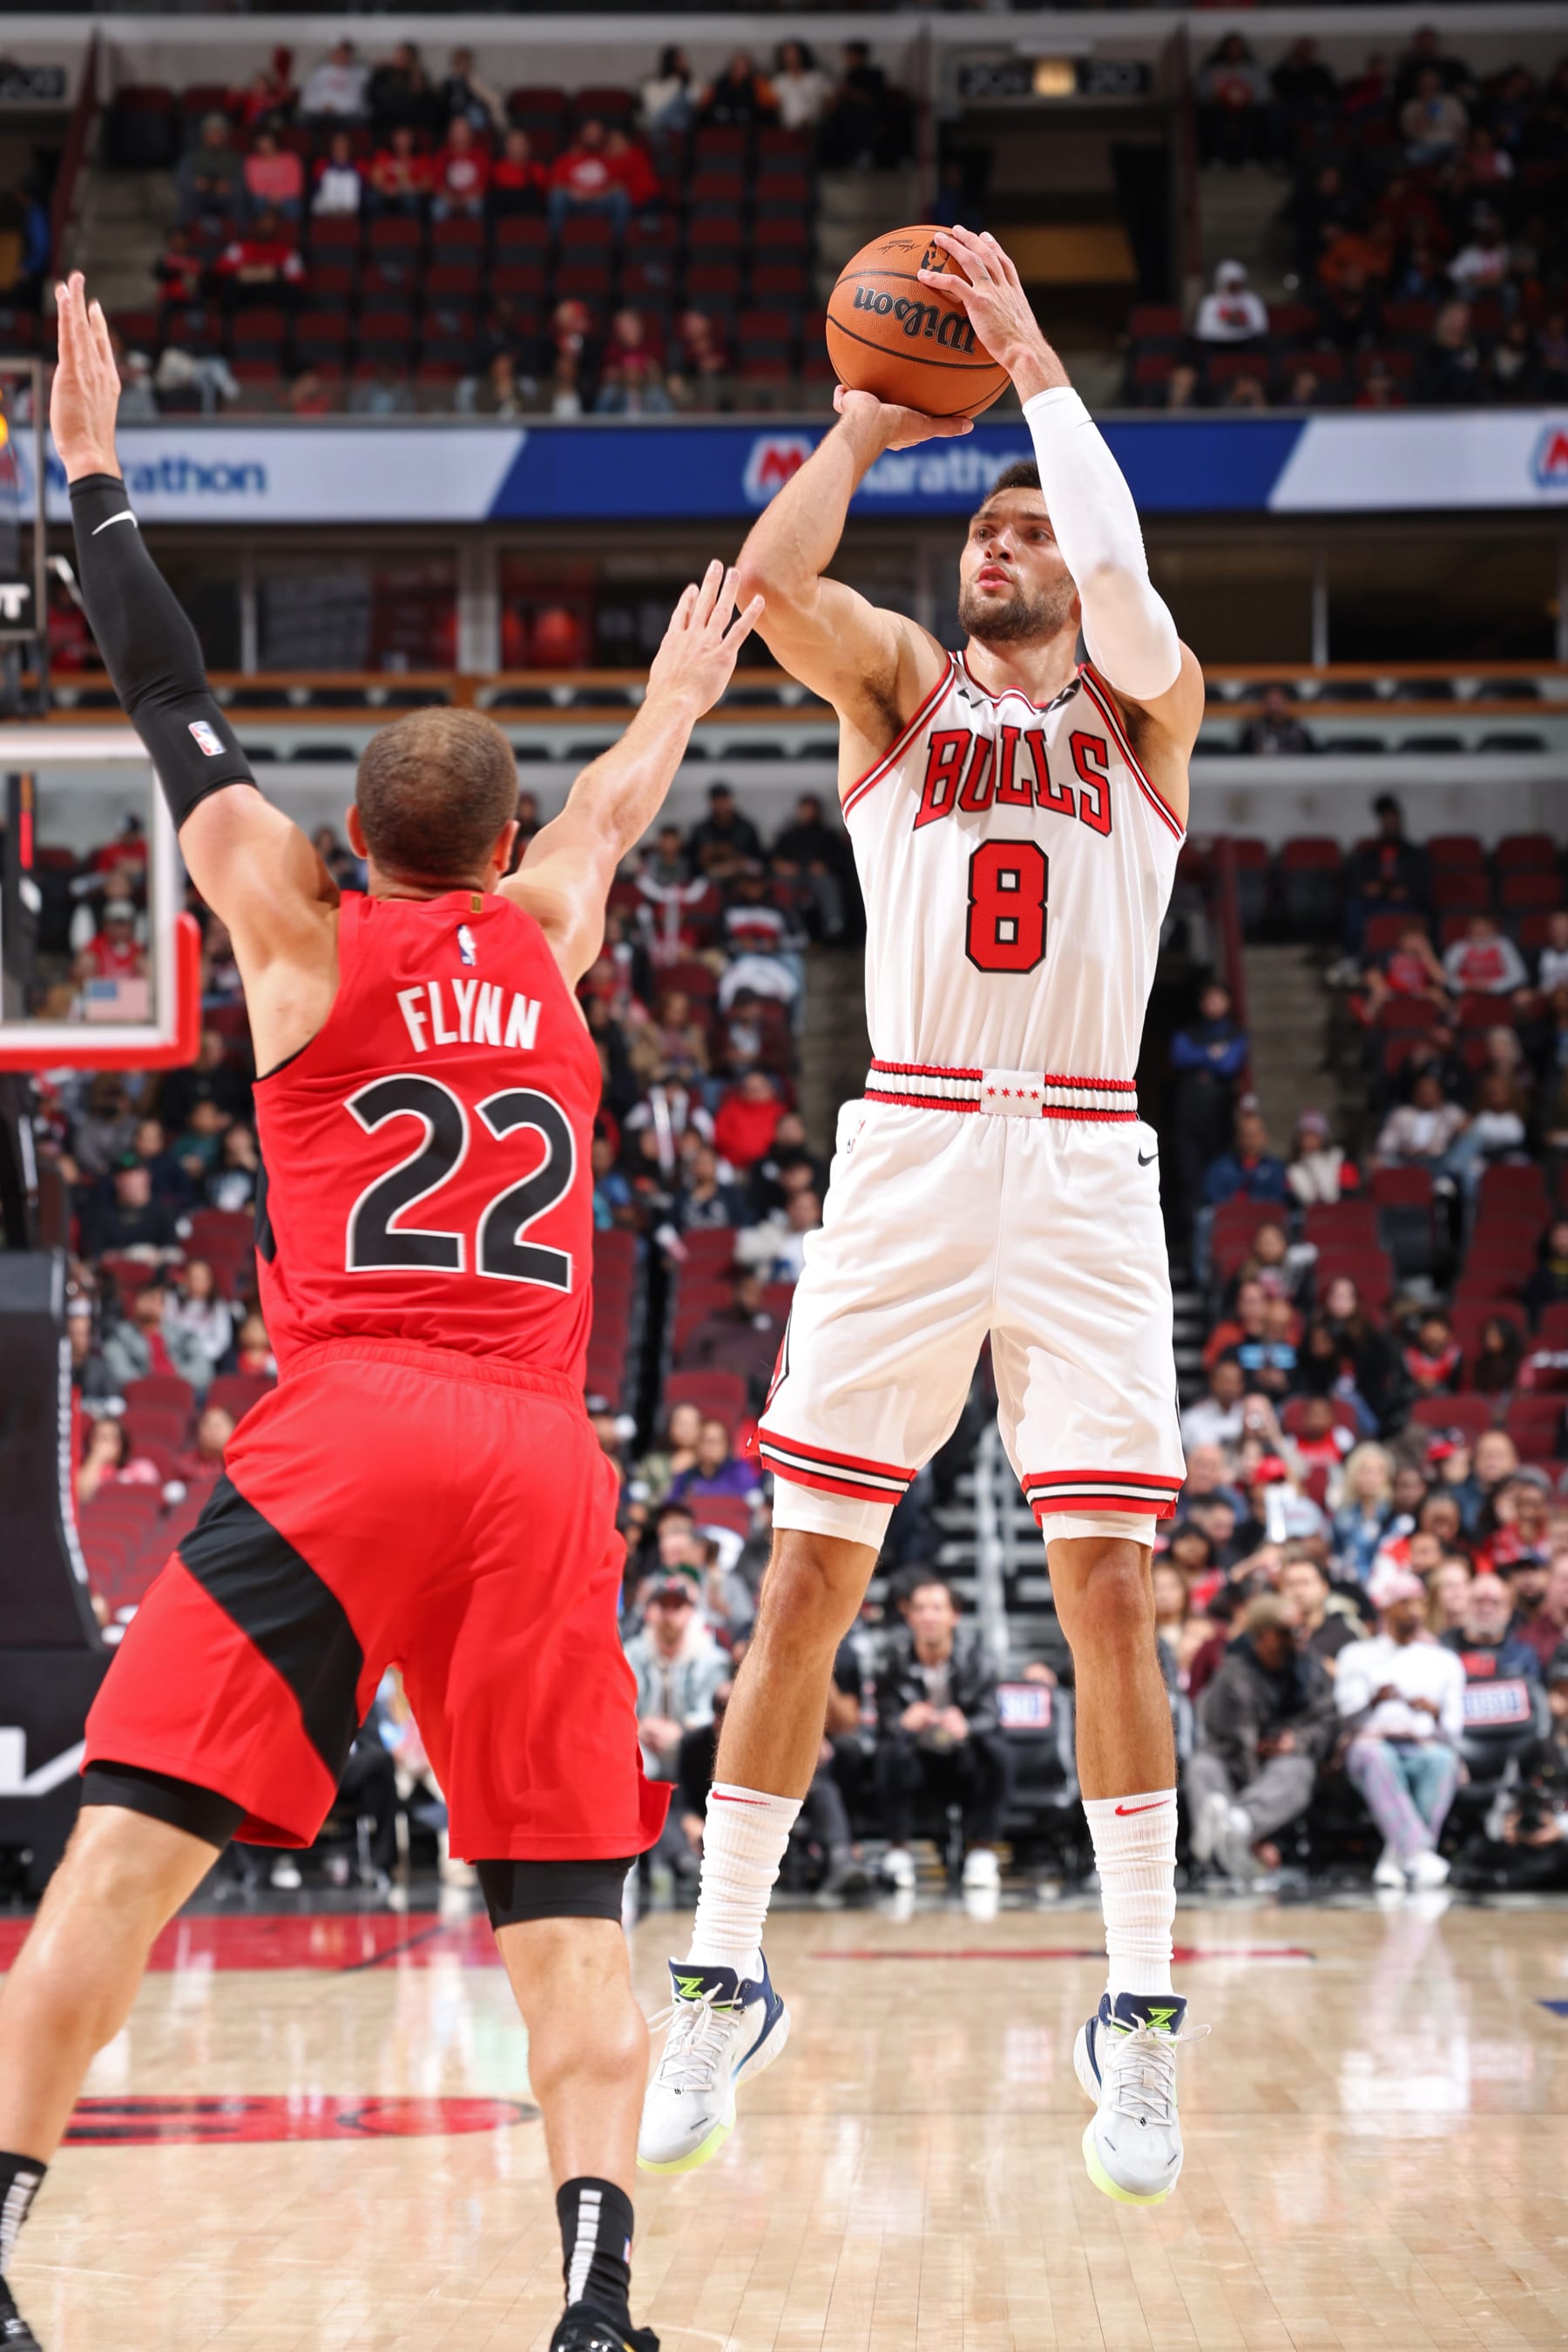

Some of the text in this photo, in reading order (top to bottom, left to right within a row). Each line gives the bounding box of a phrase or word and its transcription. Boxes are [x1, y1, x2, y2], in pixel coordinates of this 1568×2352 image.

[853, 285, 976, 356] Wilson
[913, 725, 1112, 838] BULLS
[964, 838, 1049, 975] 8
[396, 978, 542, 1053] FLYNN
[343, 1072, 577, 1294] 22
